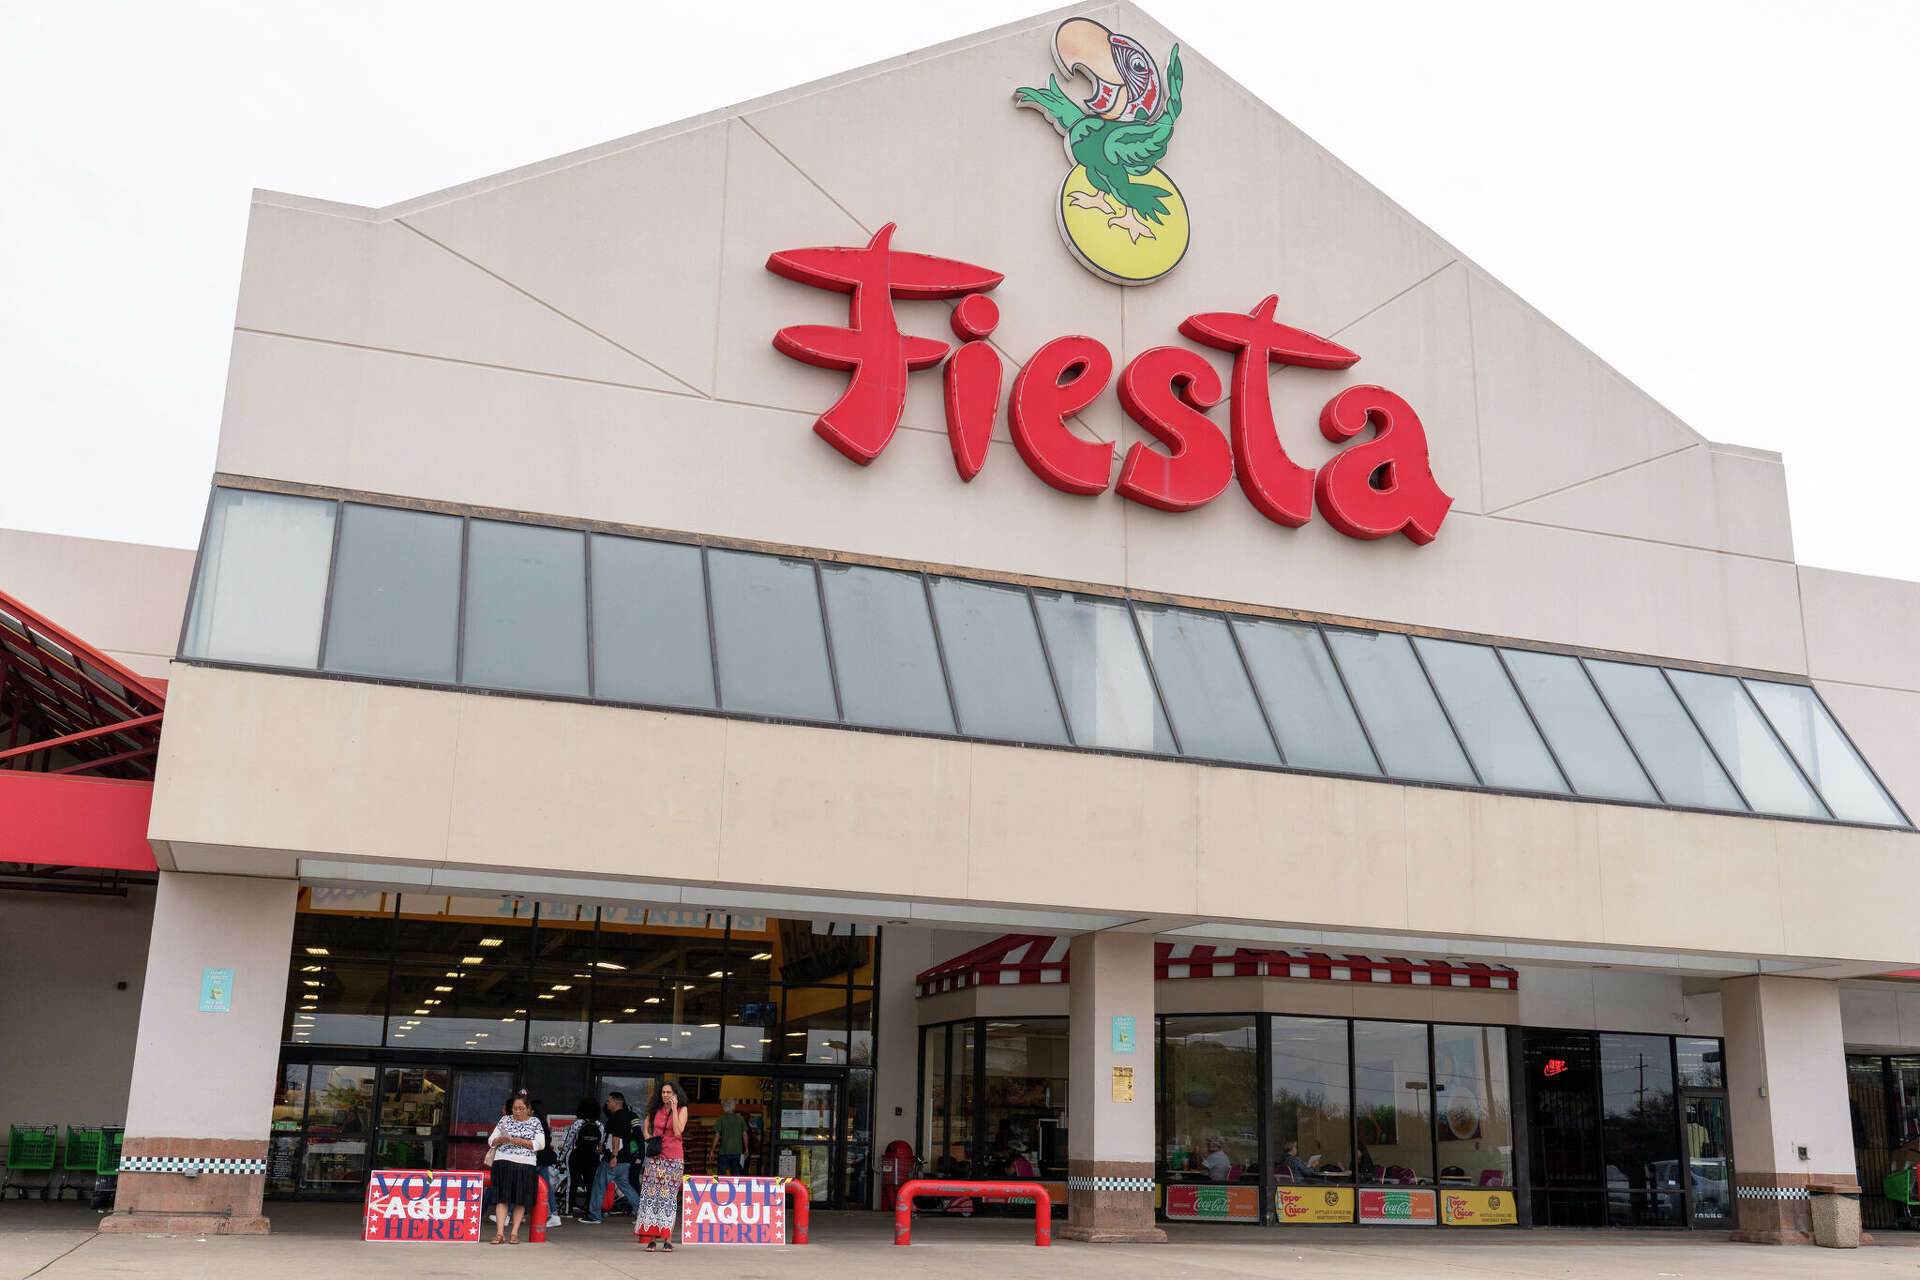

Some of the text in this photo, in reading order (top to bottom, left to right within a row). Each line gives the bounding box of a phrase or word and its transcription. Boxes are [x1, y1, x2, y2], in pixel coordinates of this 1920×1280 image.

[765, 222, 1455, 546] Fiesta
[375, 1173, 481, 1202] VOTE
[687, 1179, 783, 1207] VOTE
[1280, 1190, 1303, 1205] Topo
[383, 1196, 466, 1220] AQUI
[696, 1202, 771, 1225] AQUI
[1285, 1203, 1310, 1218] Chico
[384, 1218, 465, 1240] HERE
[697, 1223, 771, 1244] HERE
